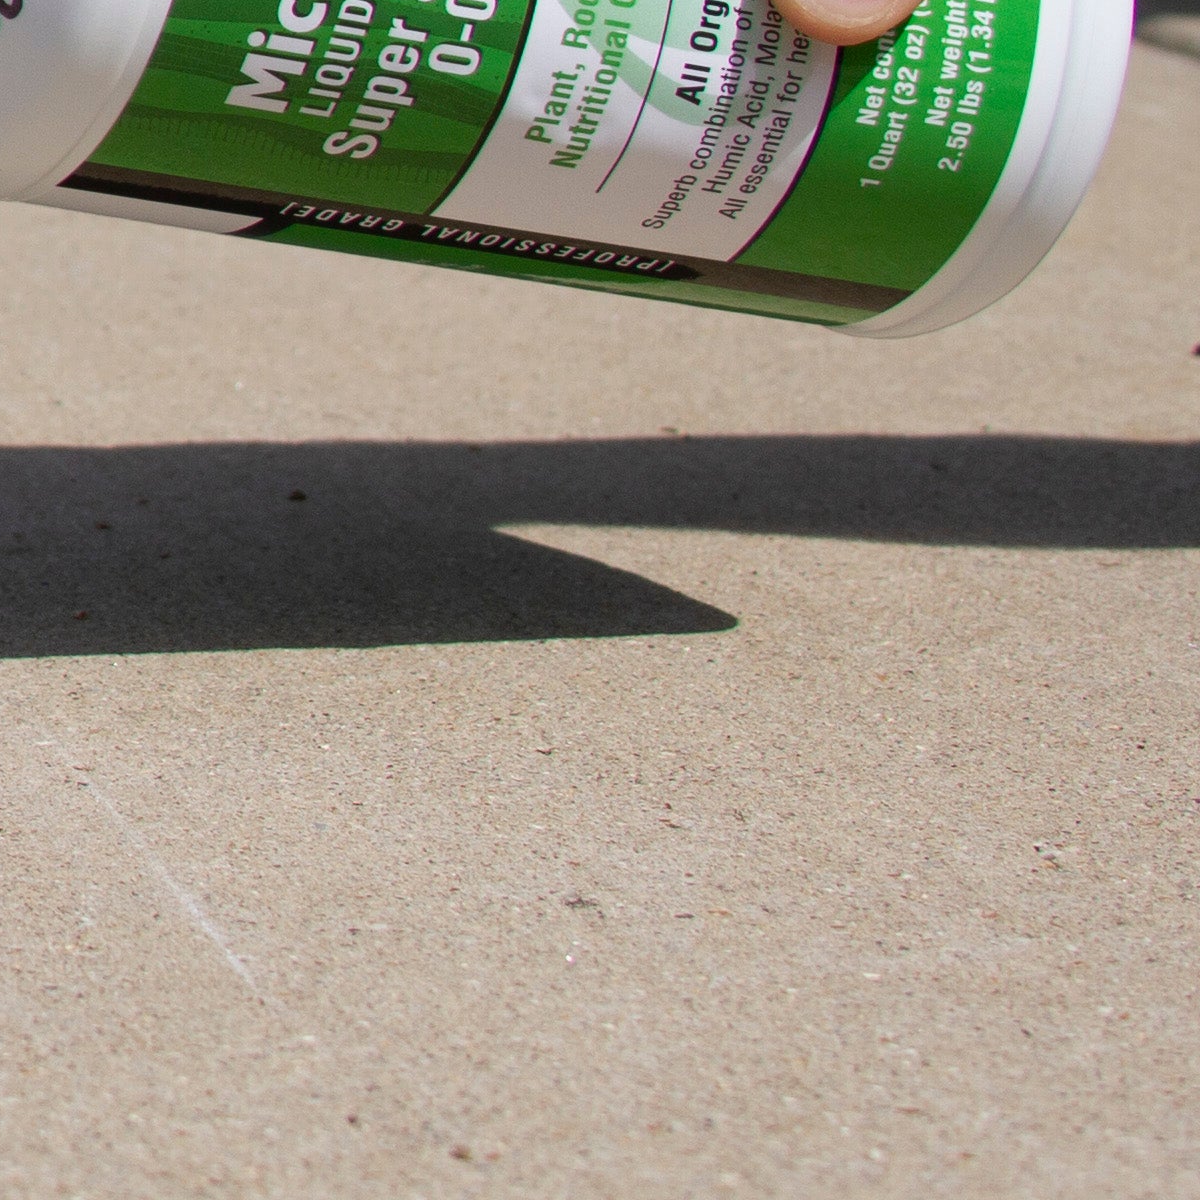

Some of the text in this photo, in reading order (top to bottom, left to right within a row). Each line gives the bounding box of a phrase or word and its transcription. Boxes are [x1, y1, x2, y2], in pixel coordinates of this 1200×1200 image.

[904, 24, 931, 61] oz)
[965, 9, 994, 75] (1.34
[322, 17, 429, 159] Super
[524, 63, 586, 144] Plant,
[549, 19, 632, 169] Nutritional
[675, 63, 711, 106] All
[854, 85, 887, 127] Net
[891, 66, 921, 106] (32
[924, 85, 956, 127] Net
[956, 80, 986, 117] lbs
[641, 174, 698, 229] Superb
[689, 39, 750, 170] combination
[733, 6, 754, 30] of
[701, 133, 751, 194] Humic
[735, 75, 776, 129] Acid,
[718, 198, 748, 220] All
[739, 109, 793, 195] essential
[780, 70, 804, 105] for
[867, 109, 910, 172] Quart
[937, 121, 974, 173] 2.50
[860, 177, 882, 189] 1
